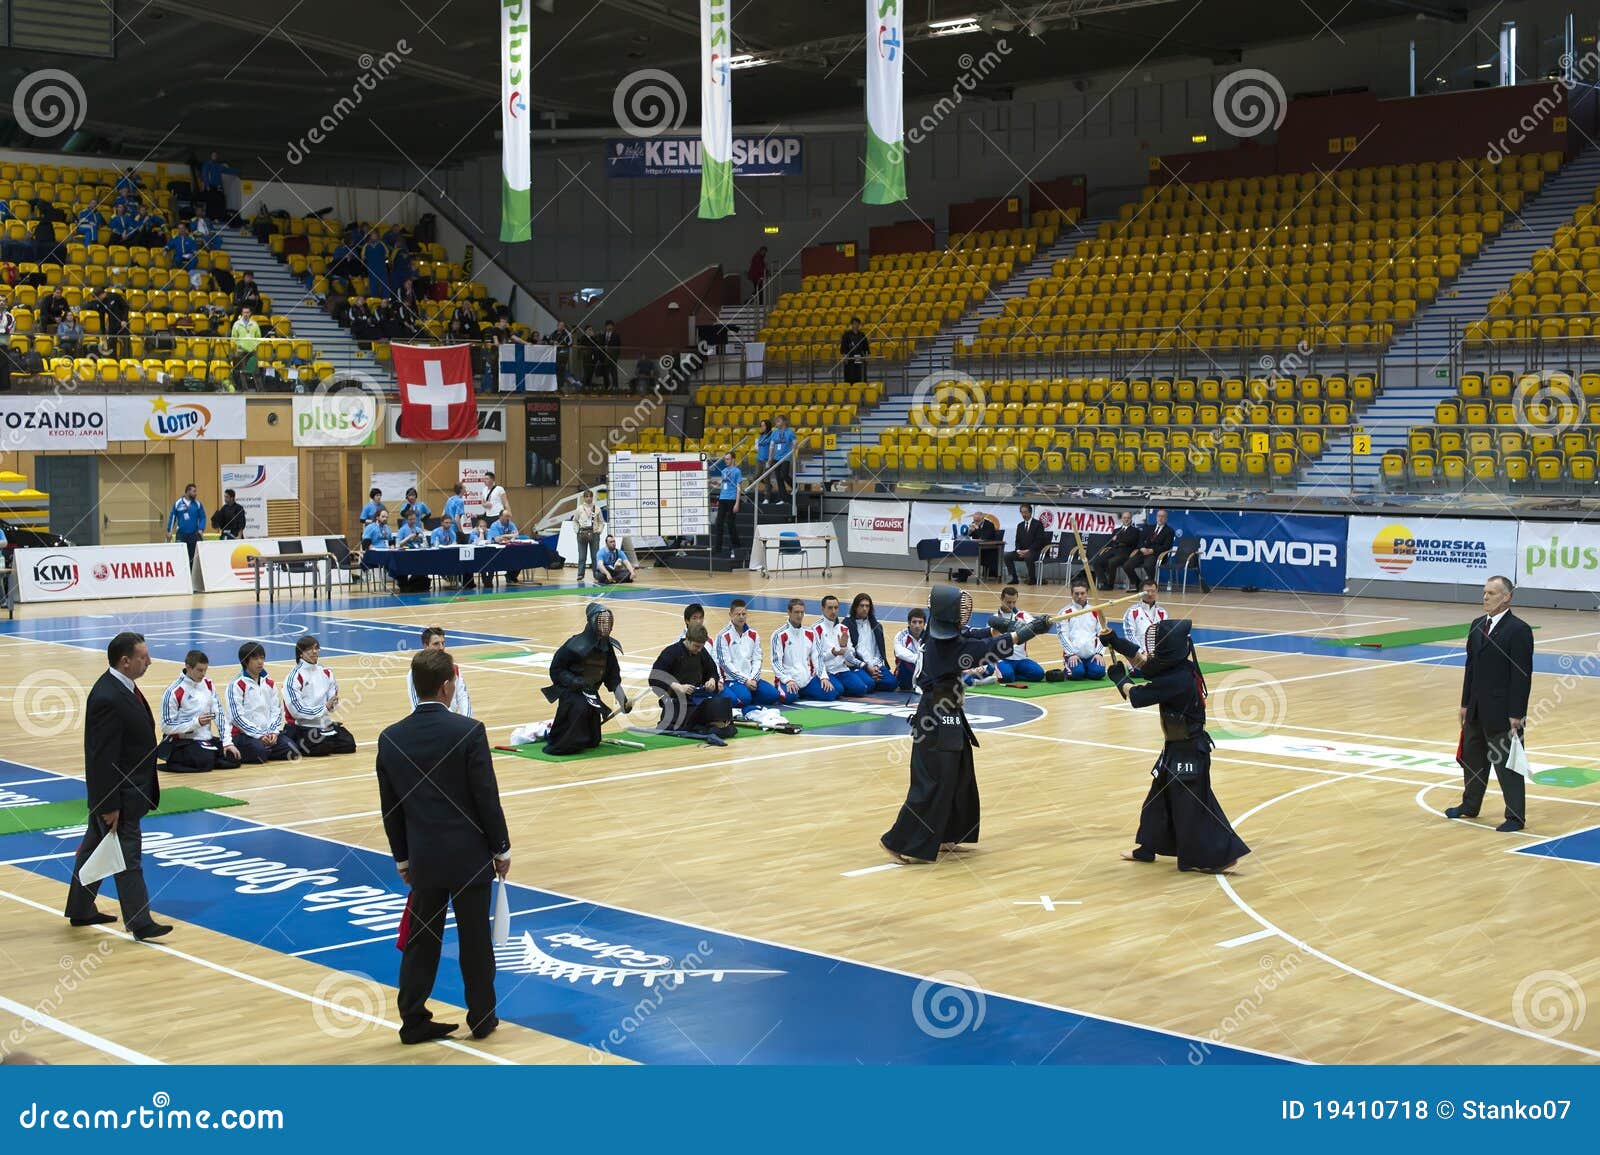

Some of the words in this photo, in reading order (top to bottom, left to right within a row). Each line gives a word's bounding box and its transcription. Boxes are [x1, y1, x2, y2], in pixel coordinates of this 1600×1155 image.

[645, 140, 702, 166] KEN
[732, 139, 800, 165] SHOP
[157, 411, 198, 434] LOTTO
[298, 406, 350, 437] plus
[1359, 441, 1366, 452] 2
[639, 462, 654, 470] POOL
[1056, 511, 1116, 533] YAMAHA
[1393, 538, 1486, 550] POMORSKA
[1393, 549, 1447, 557] SPECJALNA
[1449, 551, 1488, 559] STREFA
[1415, 556, 1488, 565] EKONOMICZNA
[1525, 536, 1599, 575] plus
[110, 561, 175, 579] YAMAHA
[942, 715, 955, 725] SER
